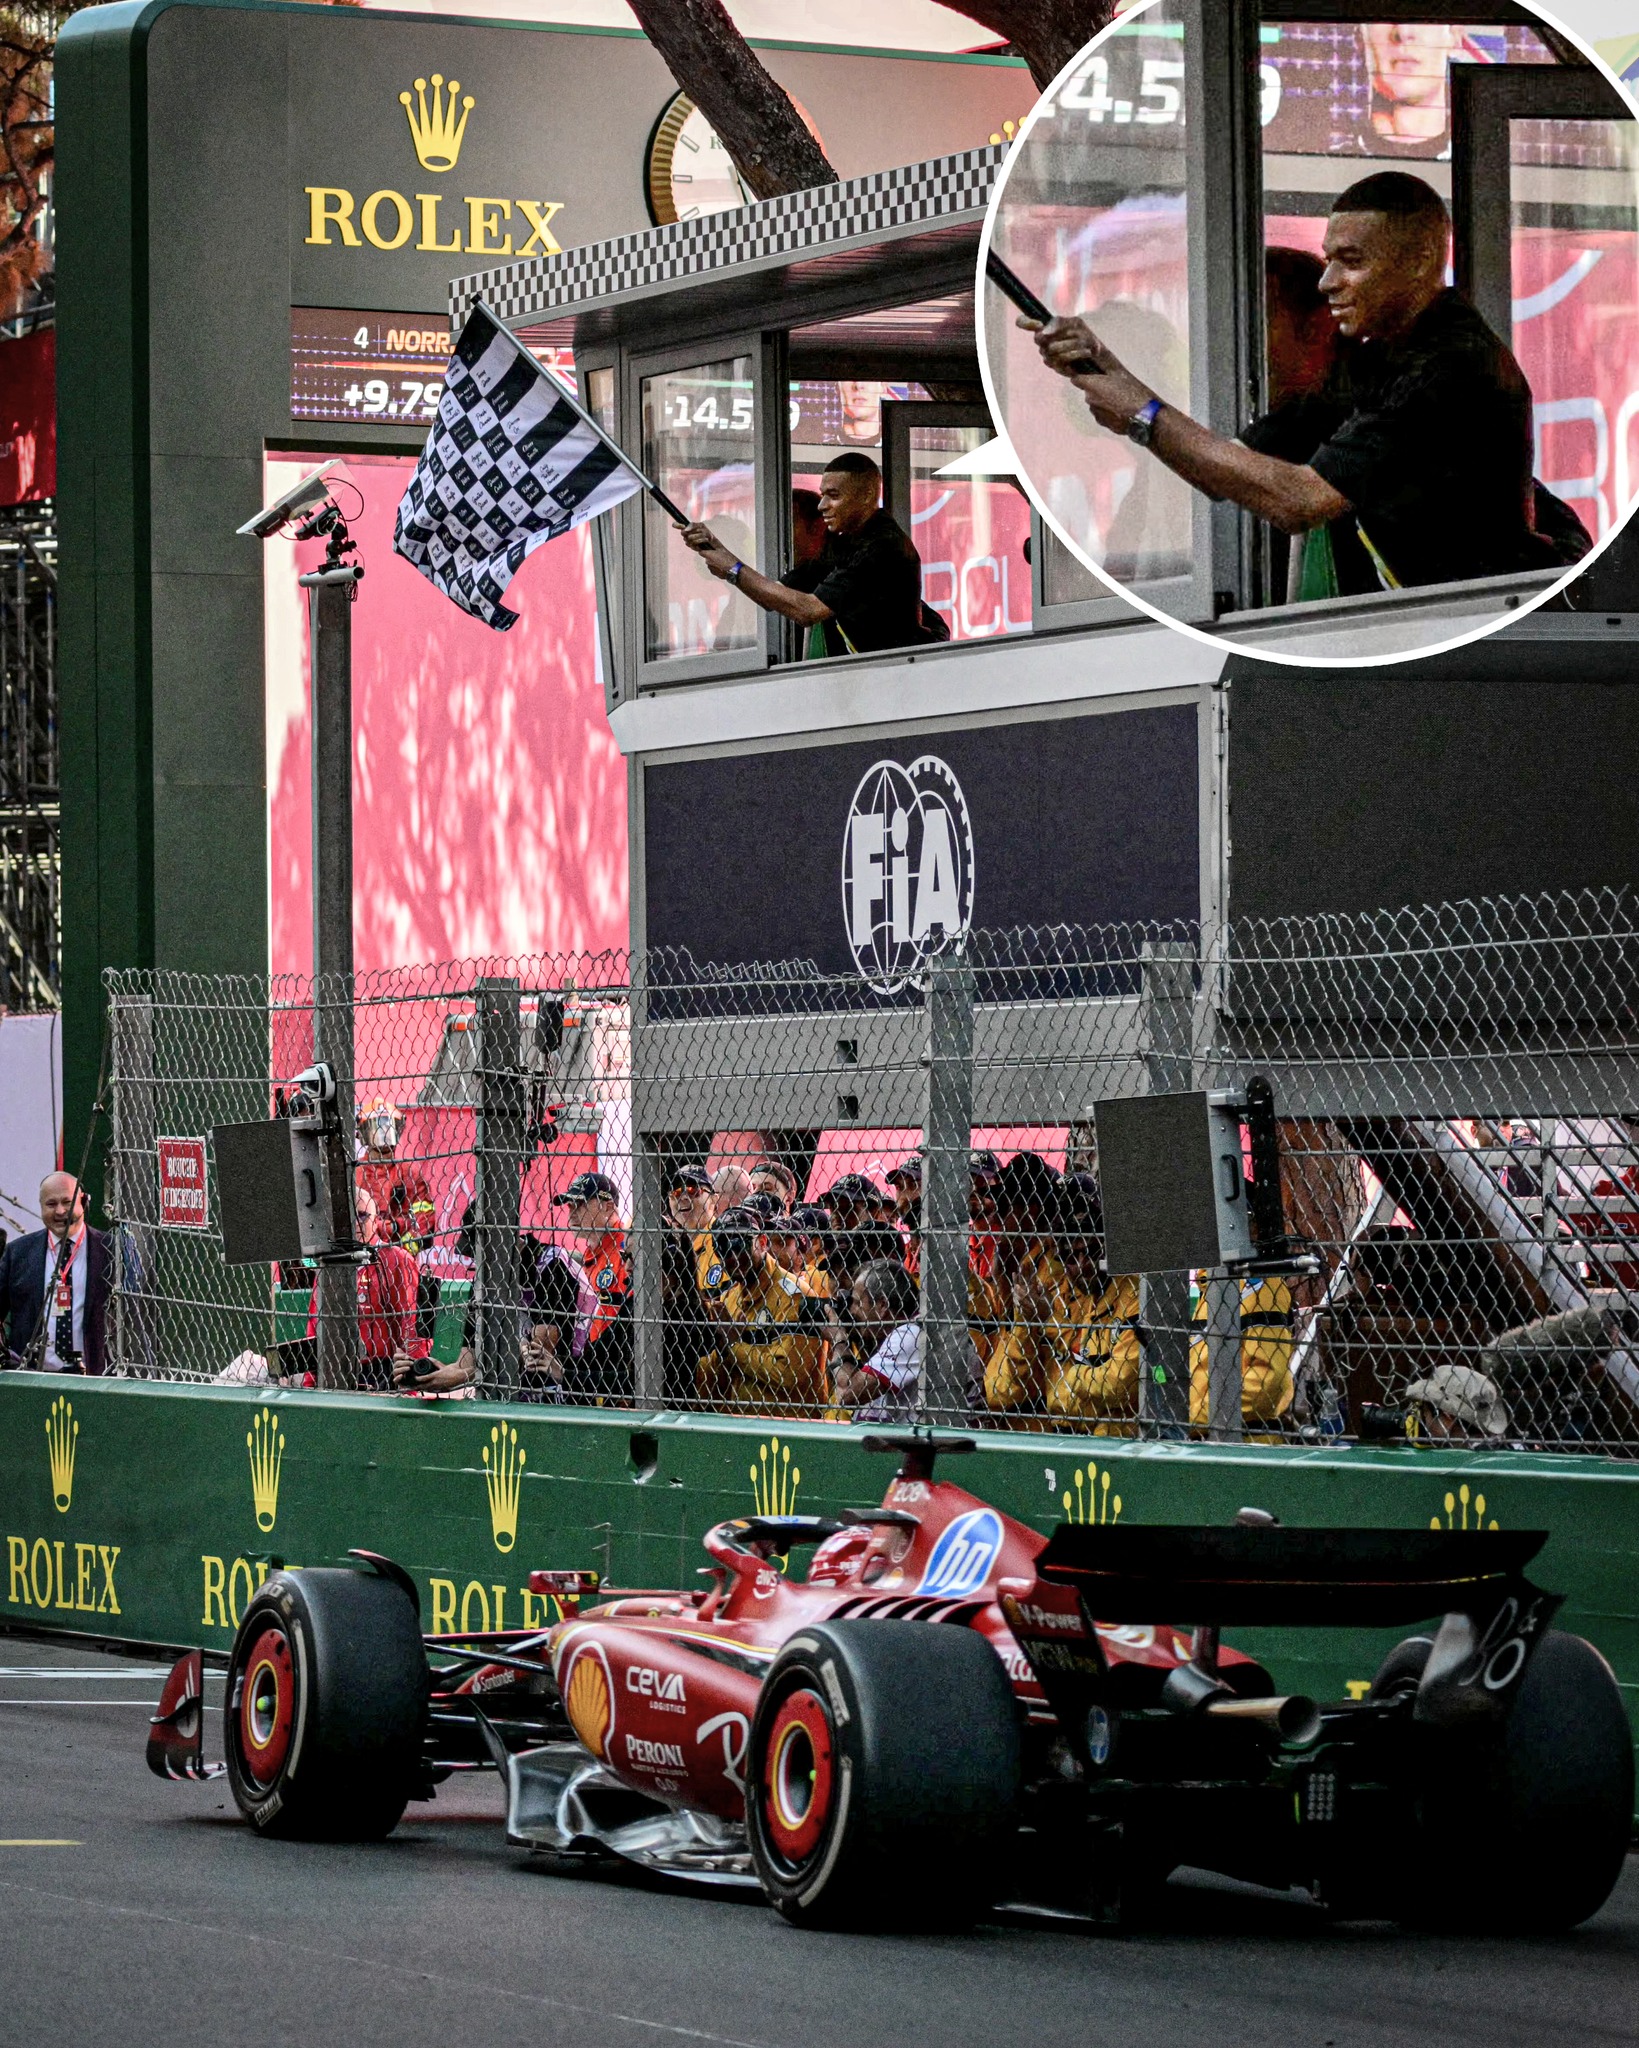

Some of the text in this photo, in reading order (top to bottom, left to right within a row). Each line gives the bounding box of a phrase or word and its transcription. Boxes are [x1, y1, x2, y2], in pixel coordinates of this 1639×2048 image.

[304, 186, 565, 257] ROLEX
[353, 326, 456, 353] 4 NORR
[7, 1536, 122, 1615] ROLEX
[625, 1734, 686, 1767] PERONI
